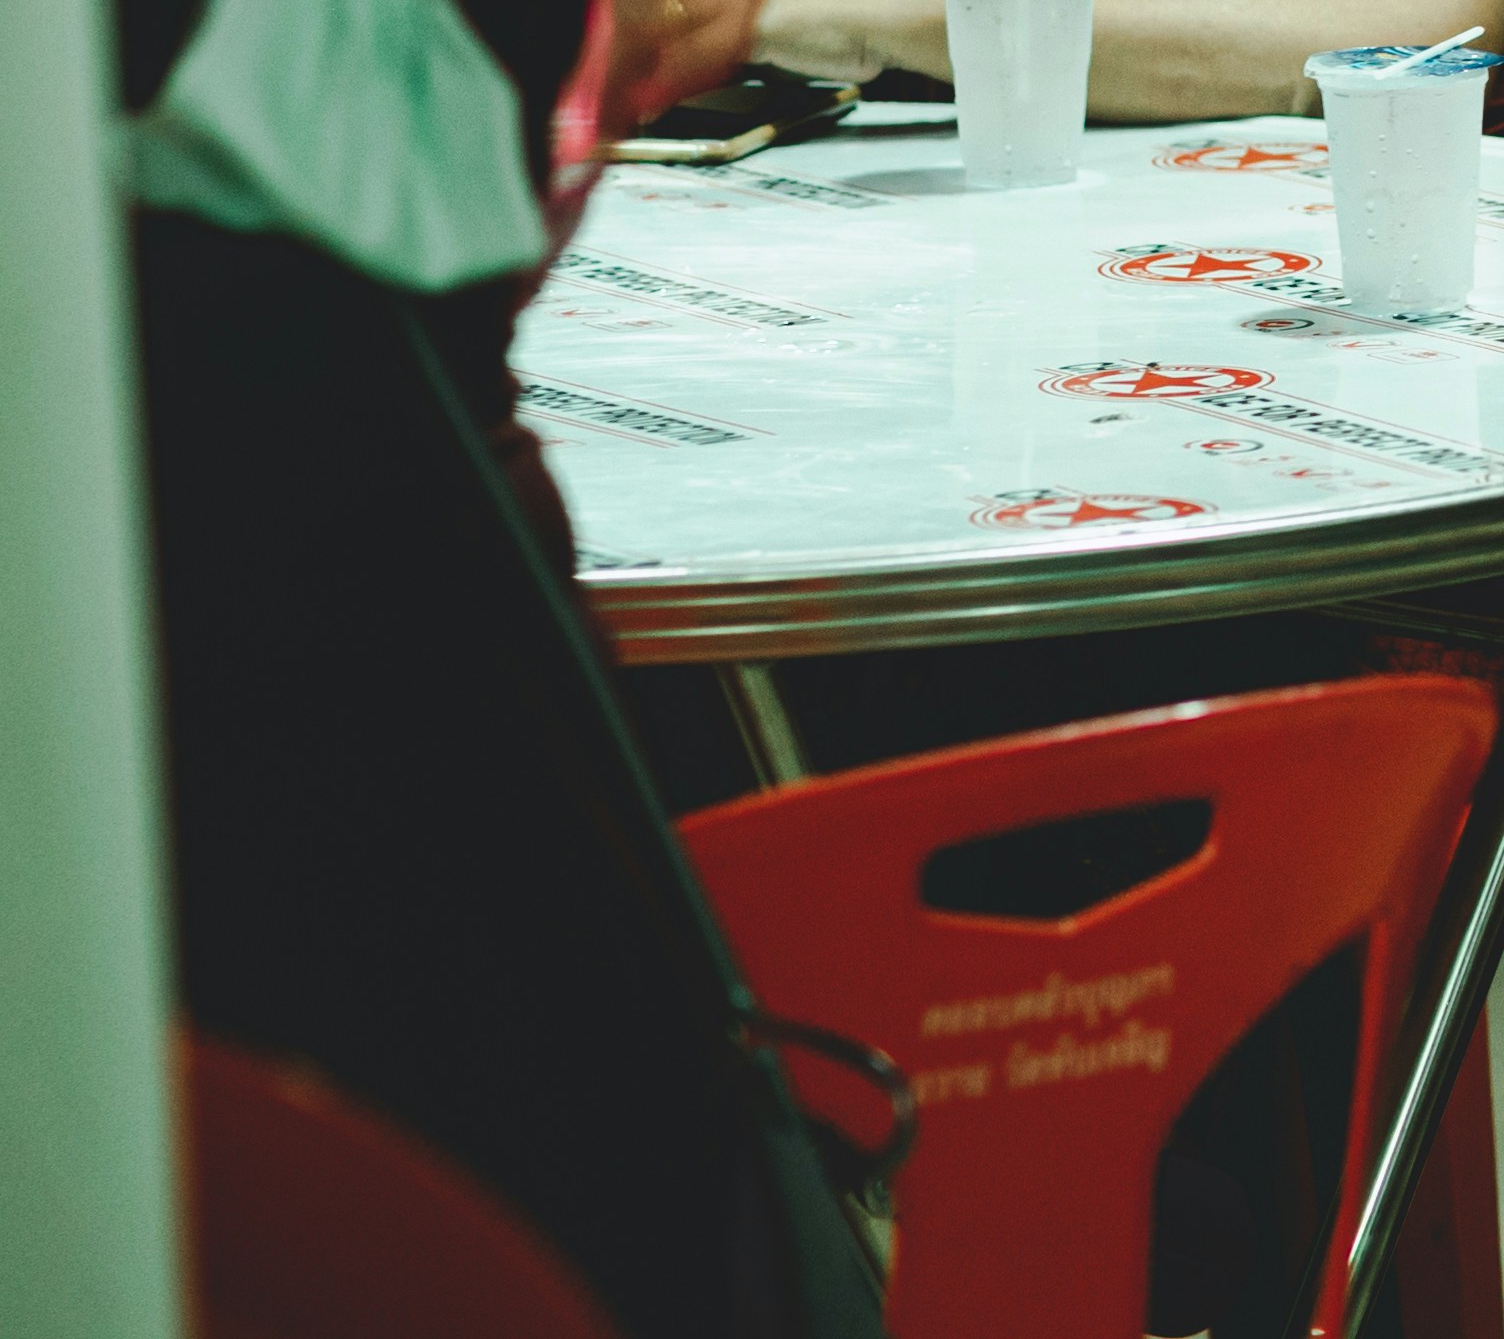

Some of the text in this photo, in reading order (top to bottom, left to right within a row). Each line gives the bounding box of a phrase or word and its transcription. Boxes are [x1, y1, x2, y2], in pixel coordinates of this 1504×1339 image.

[1192, 392, 1273, 410] ICE
[1236, 399, 1320, 423] FOR
[1290, 417, 1420, 453] PERFECT
